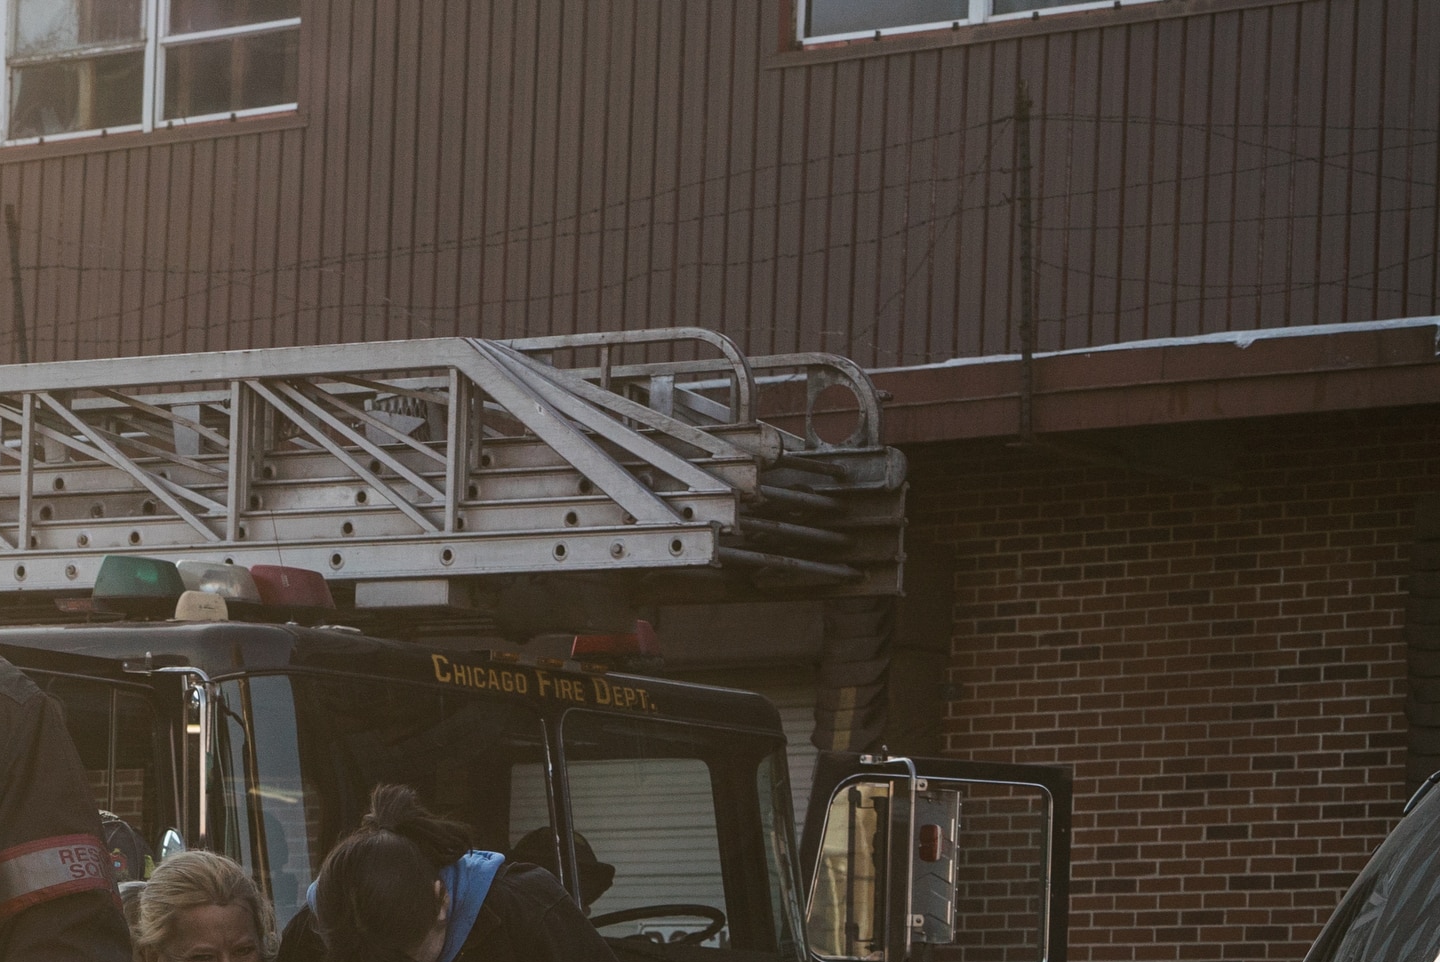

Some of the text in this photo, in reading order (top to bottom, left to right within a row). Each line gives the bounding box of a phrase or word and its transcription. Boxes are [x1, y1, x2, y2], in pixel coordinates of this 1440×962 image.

[431, 653, 657, 711] CHICAGO FIRE DEPT.
